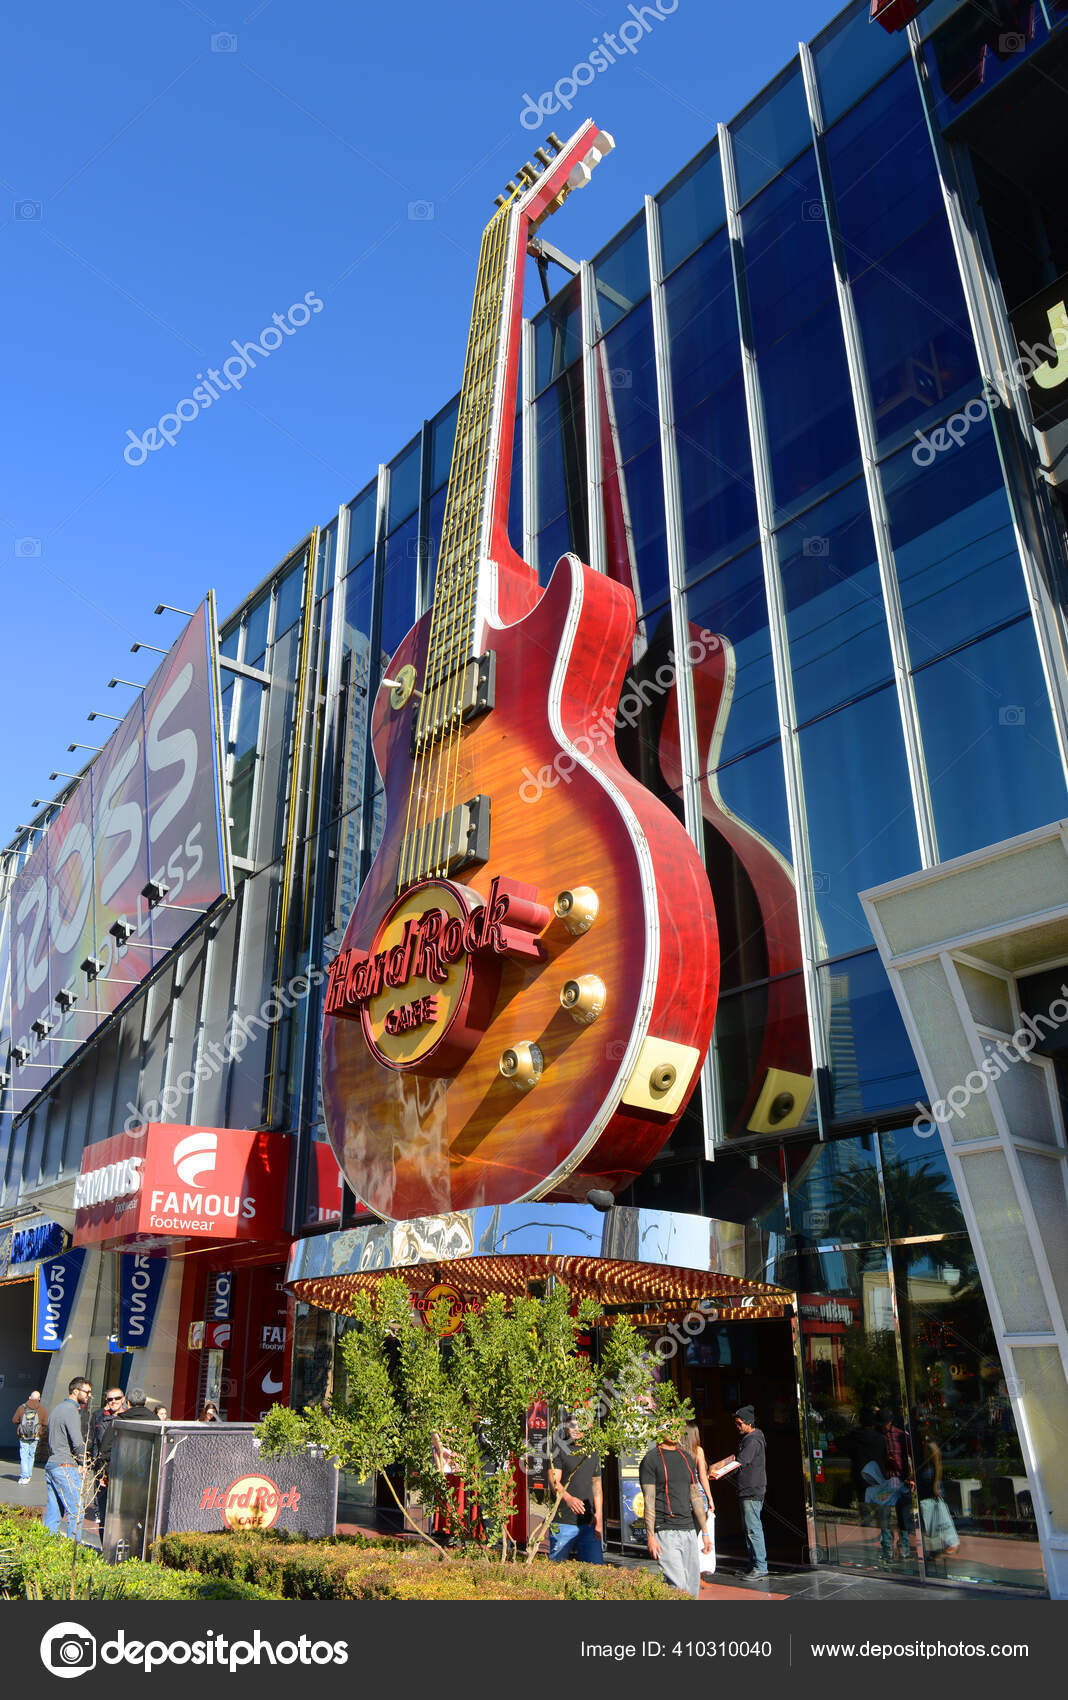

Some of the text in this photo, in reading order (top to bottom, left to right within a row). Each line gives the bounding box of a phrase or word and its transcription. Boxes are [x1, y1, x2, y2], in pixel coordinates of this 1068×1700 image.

[323, 875, 511, 1015] Hard Rock
[384, 994, 440, 1036] CAFE
[150, 1190, 256, 1219] FAMOUS
[150, 1215, 215, 1232] footwear
[43, 1265, 66, 1341] ROSS
[199, 1485, 301, 1513] Hard Rock
